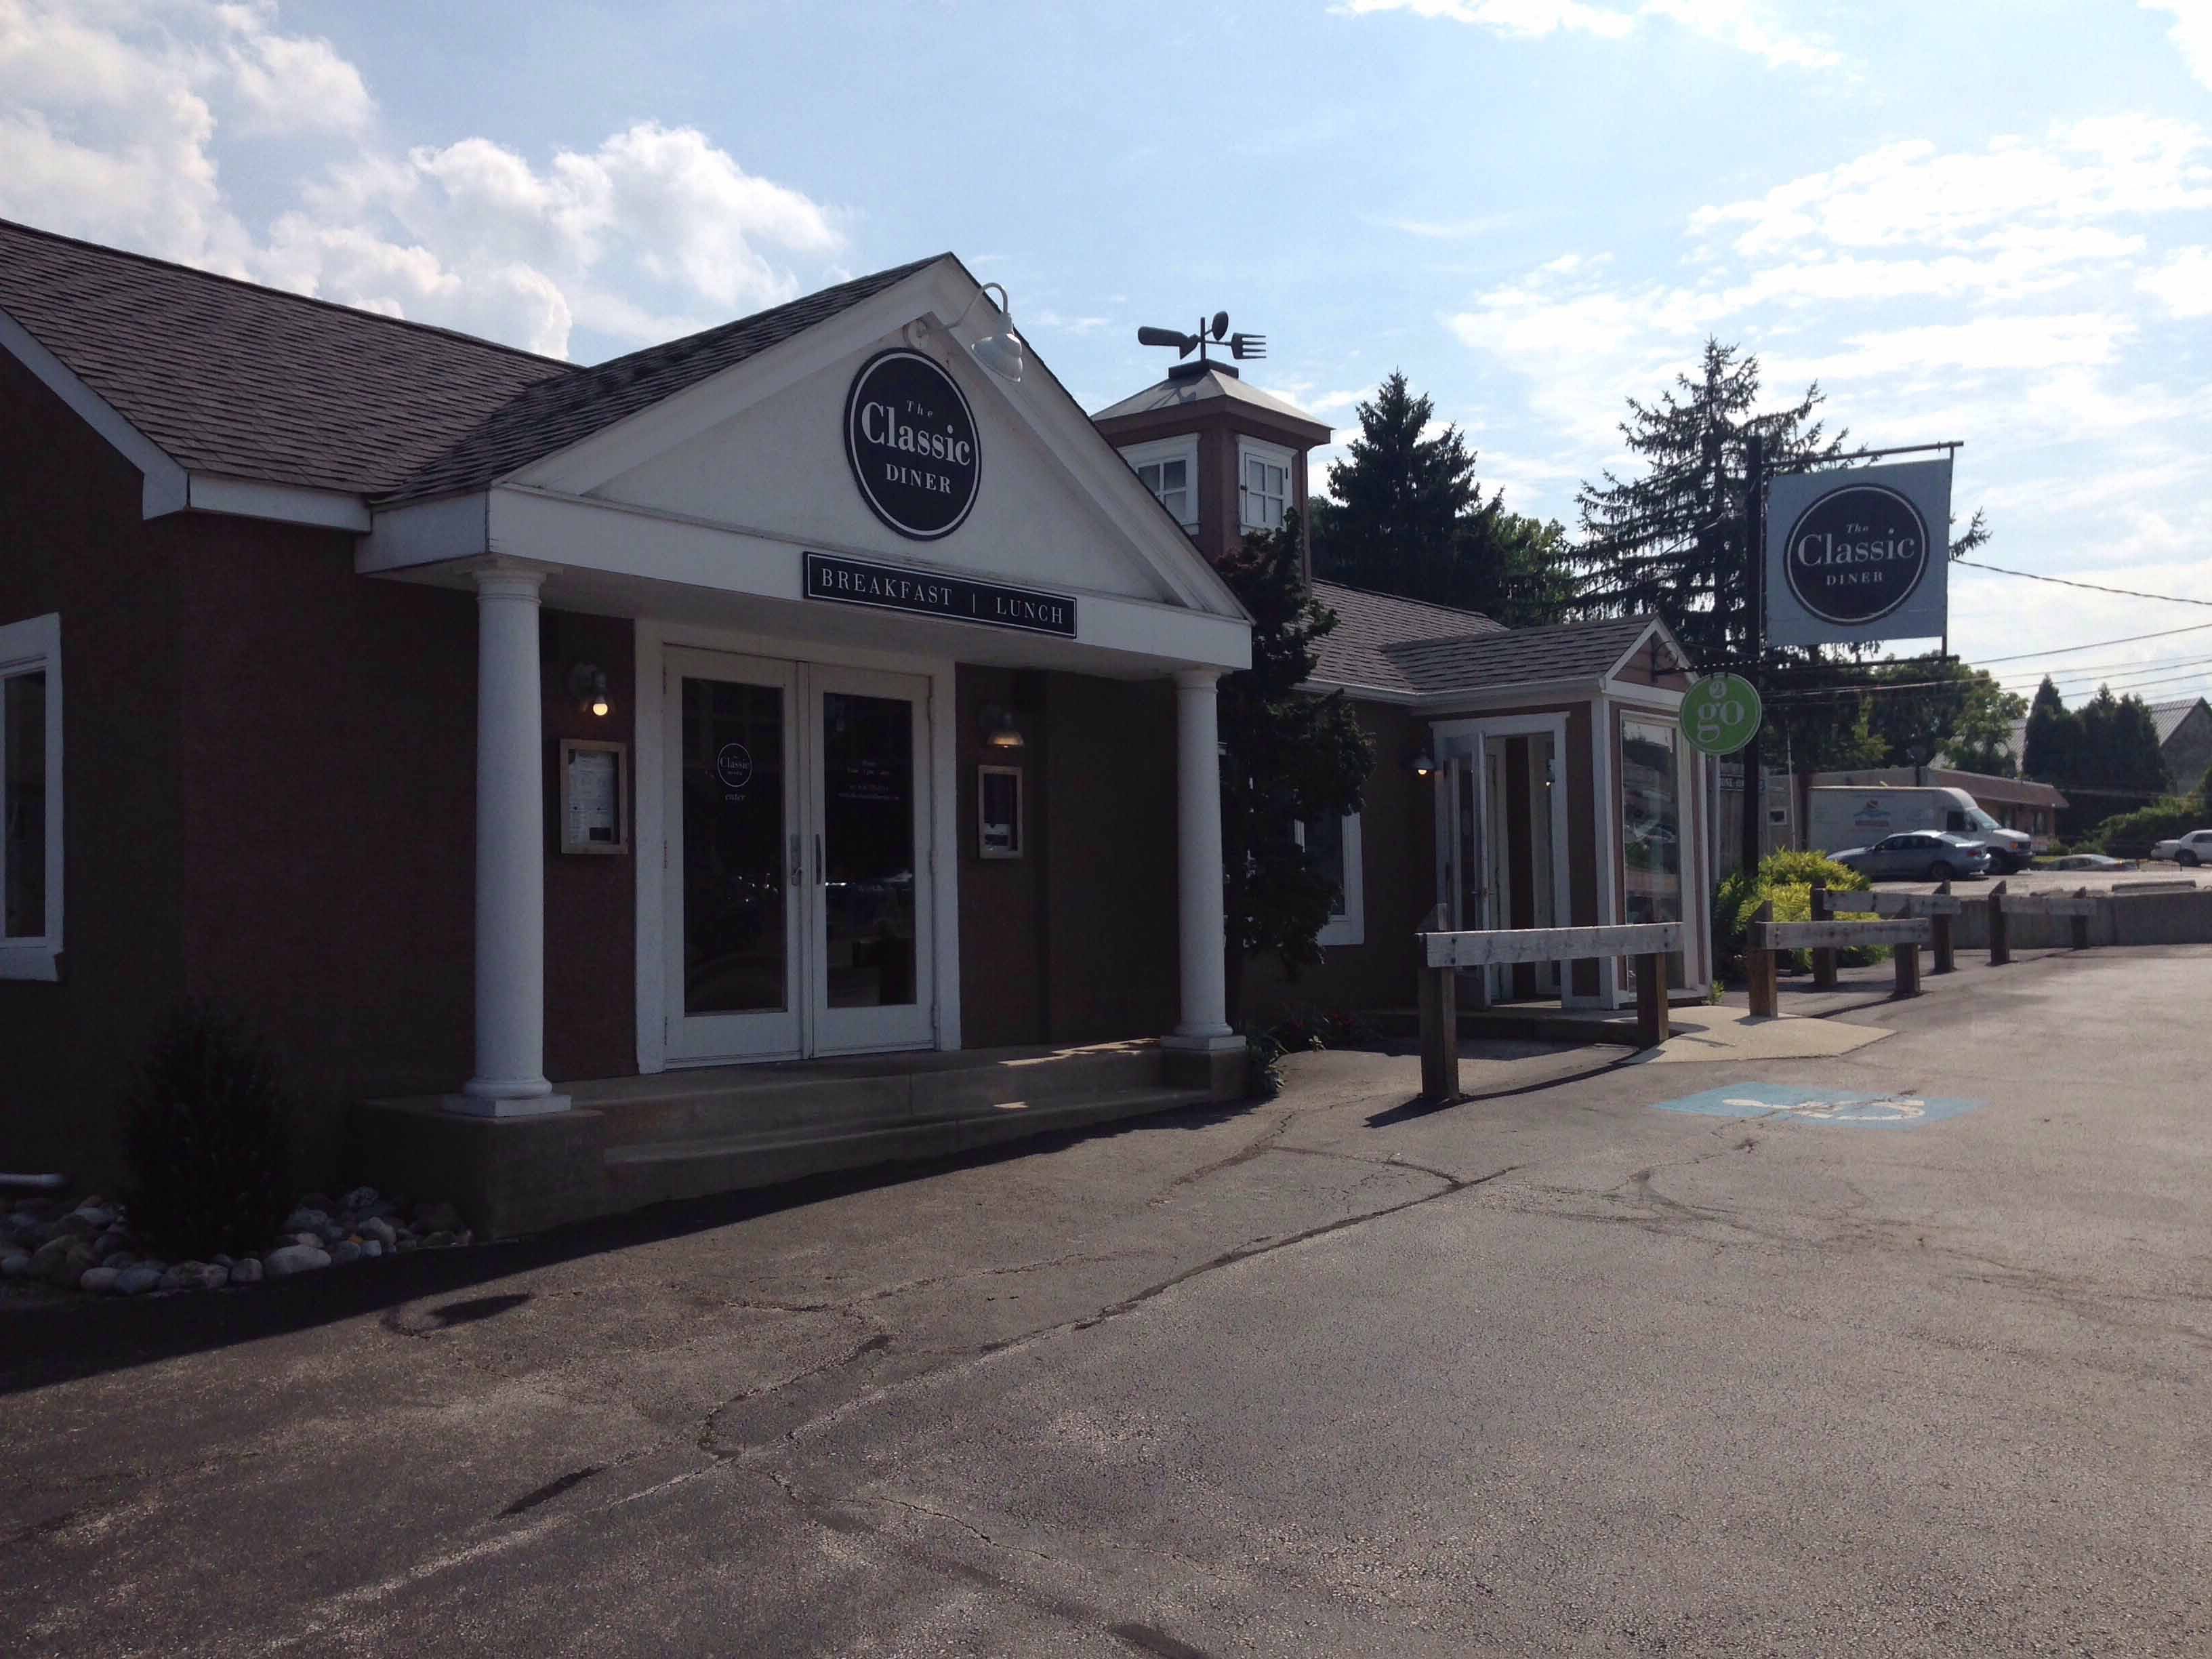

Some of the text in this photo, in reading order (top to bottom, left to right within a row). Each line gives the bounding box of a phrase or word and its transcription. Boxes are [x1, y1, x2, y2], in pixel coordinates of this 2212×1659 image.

[907, 400, 933, 418] The
[861, 401, 970, 466] Classic
[886, 464, 951, 493] DINER
[1847, 523, 1869, 533] The
[1798, 527, 1914, 567] Classic
[1826, 571, 1883, 586] DINER
[822, 568, 1063, 623] BREAKFAST LUNCH
[1713, 682, 1724, 695] 2
[1698, 700, 1744, 742] go
